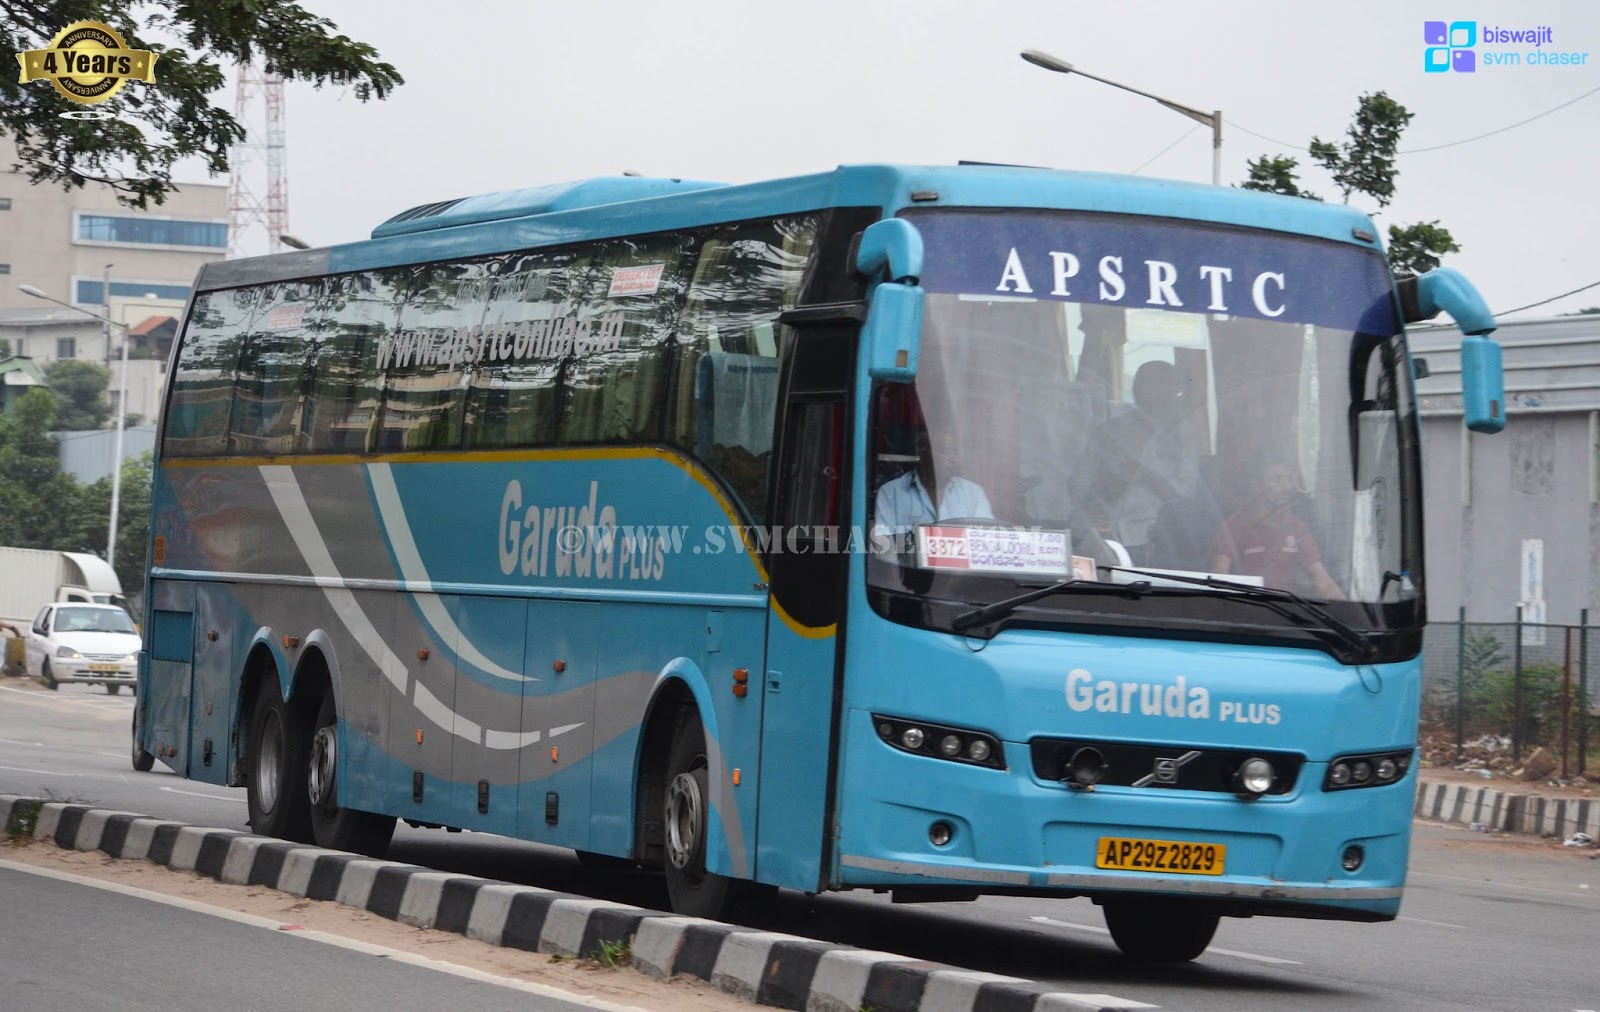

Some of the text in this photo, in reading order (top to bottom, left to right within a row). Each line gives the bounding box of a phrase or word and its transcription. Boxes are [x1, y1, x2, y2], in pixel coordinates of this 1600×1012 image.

[995, 247, 1287, 318] APSRTC
[499, 479, 665, 581] Garuda PLUS
[928, 538, 966, 557] 3872
[1064, 668, 1282, 726] Garuda PLUS
[1104, 840, 1216, 871] AP29Z2829
